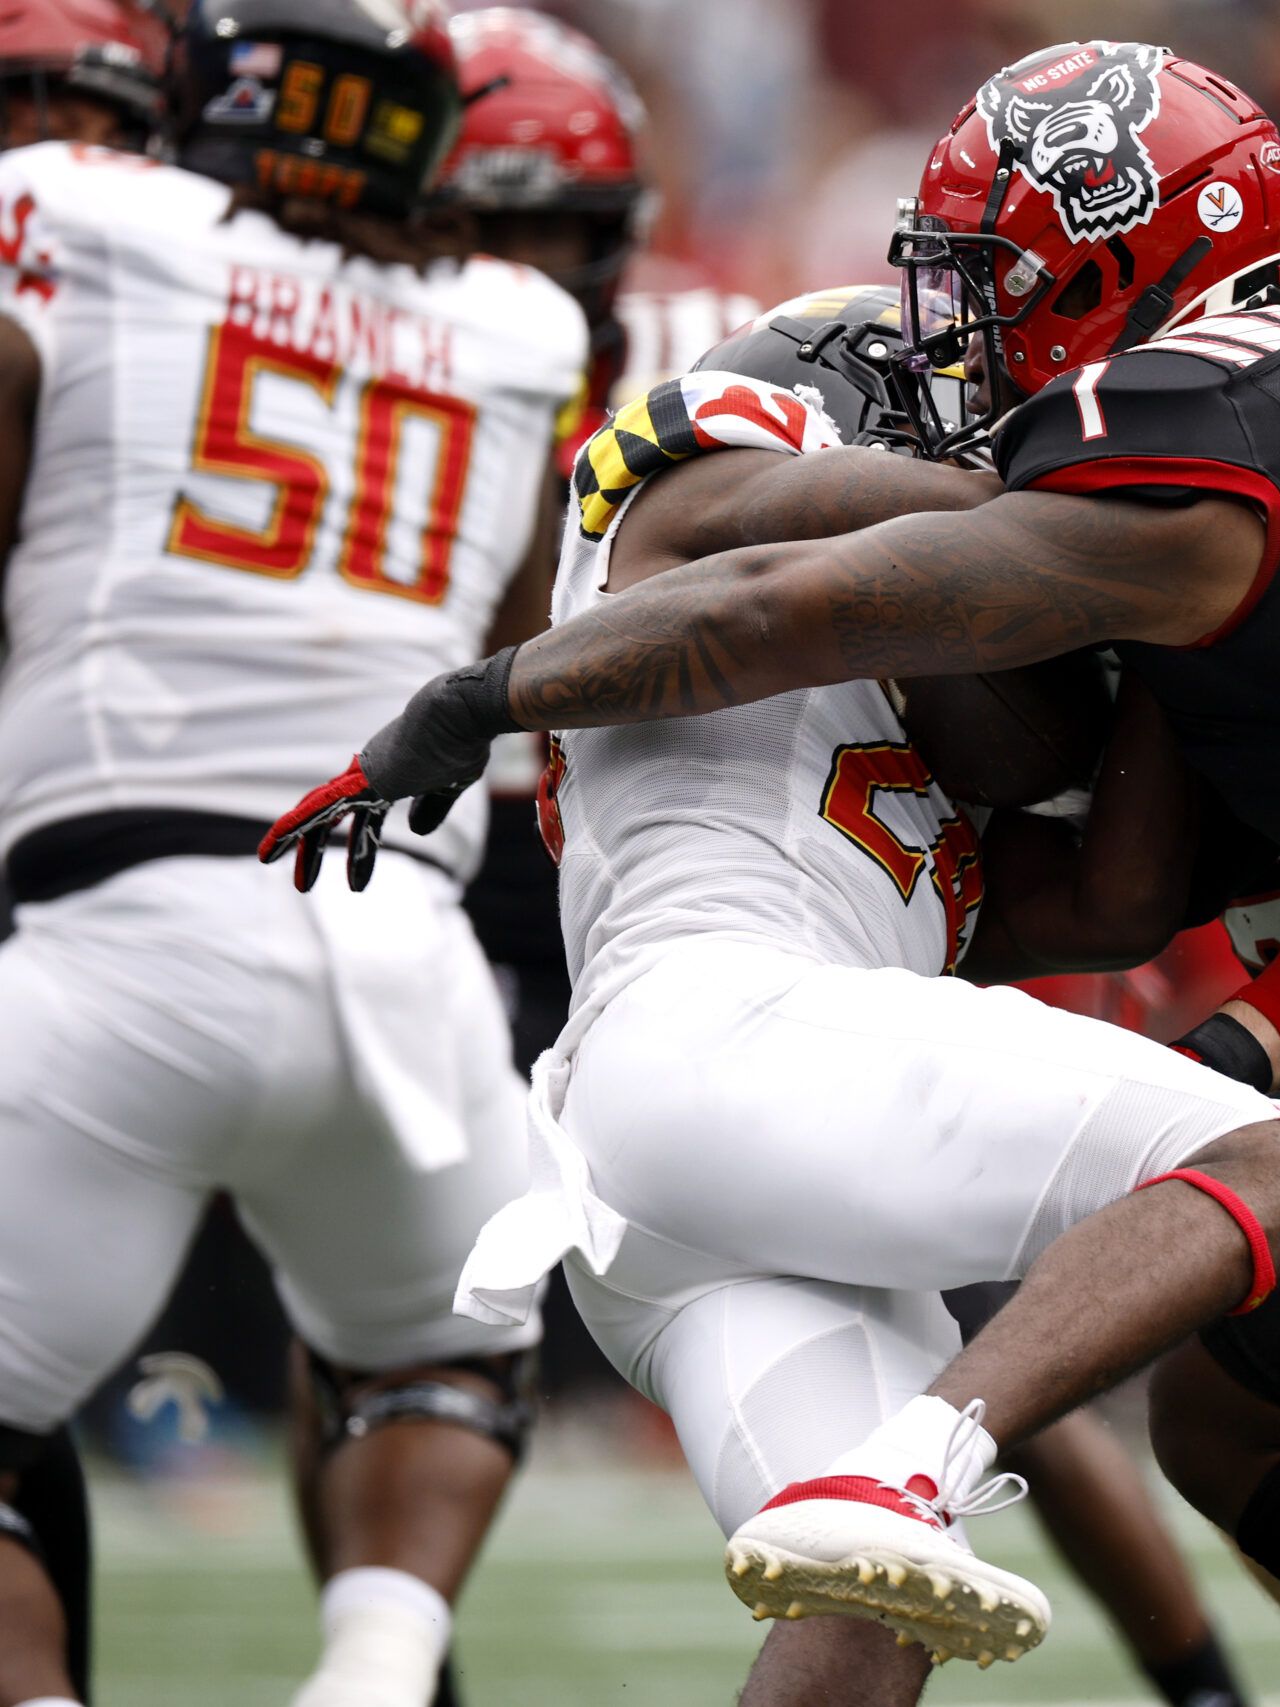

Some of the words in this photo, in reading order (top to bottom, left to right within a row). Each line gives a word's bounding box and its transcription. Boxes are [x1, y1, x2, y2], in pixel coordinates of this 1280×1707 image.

[276, 60, 372, 148] 50
[1022, 77, 1048, 92] NC
[1047, 51, 1095, 80] STATE
[1205, 187, 1225, 213] V
[228, 262, 453, 388] BRANCH
[1072, 360, 1112, 442] 1
[168, 322, 479, 608] 50
